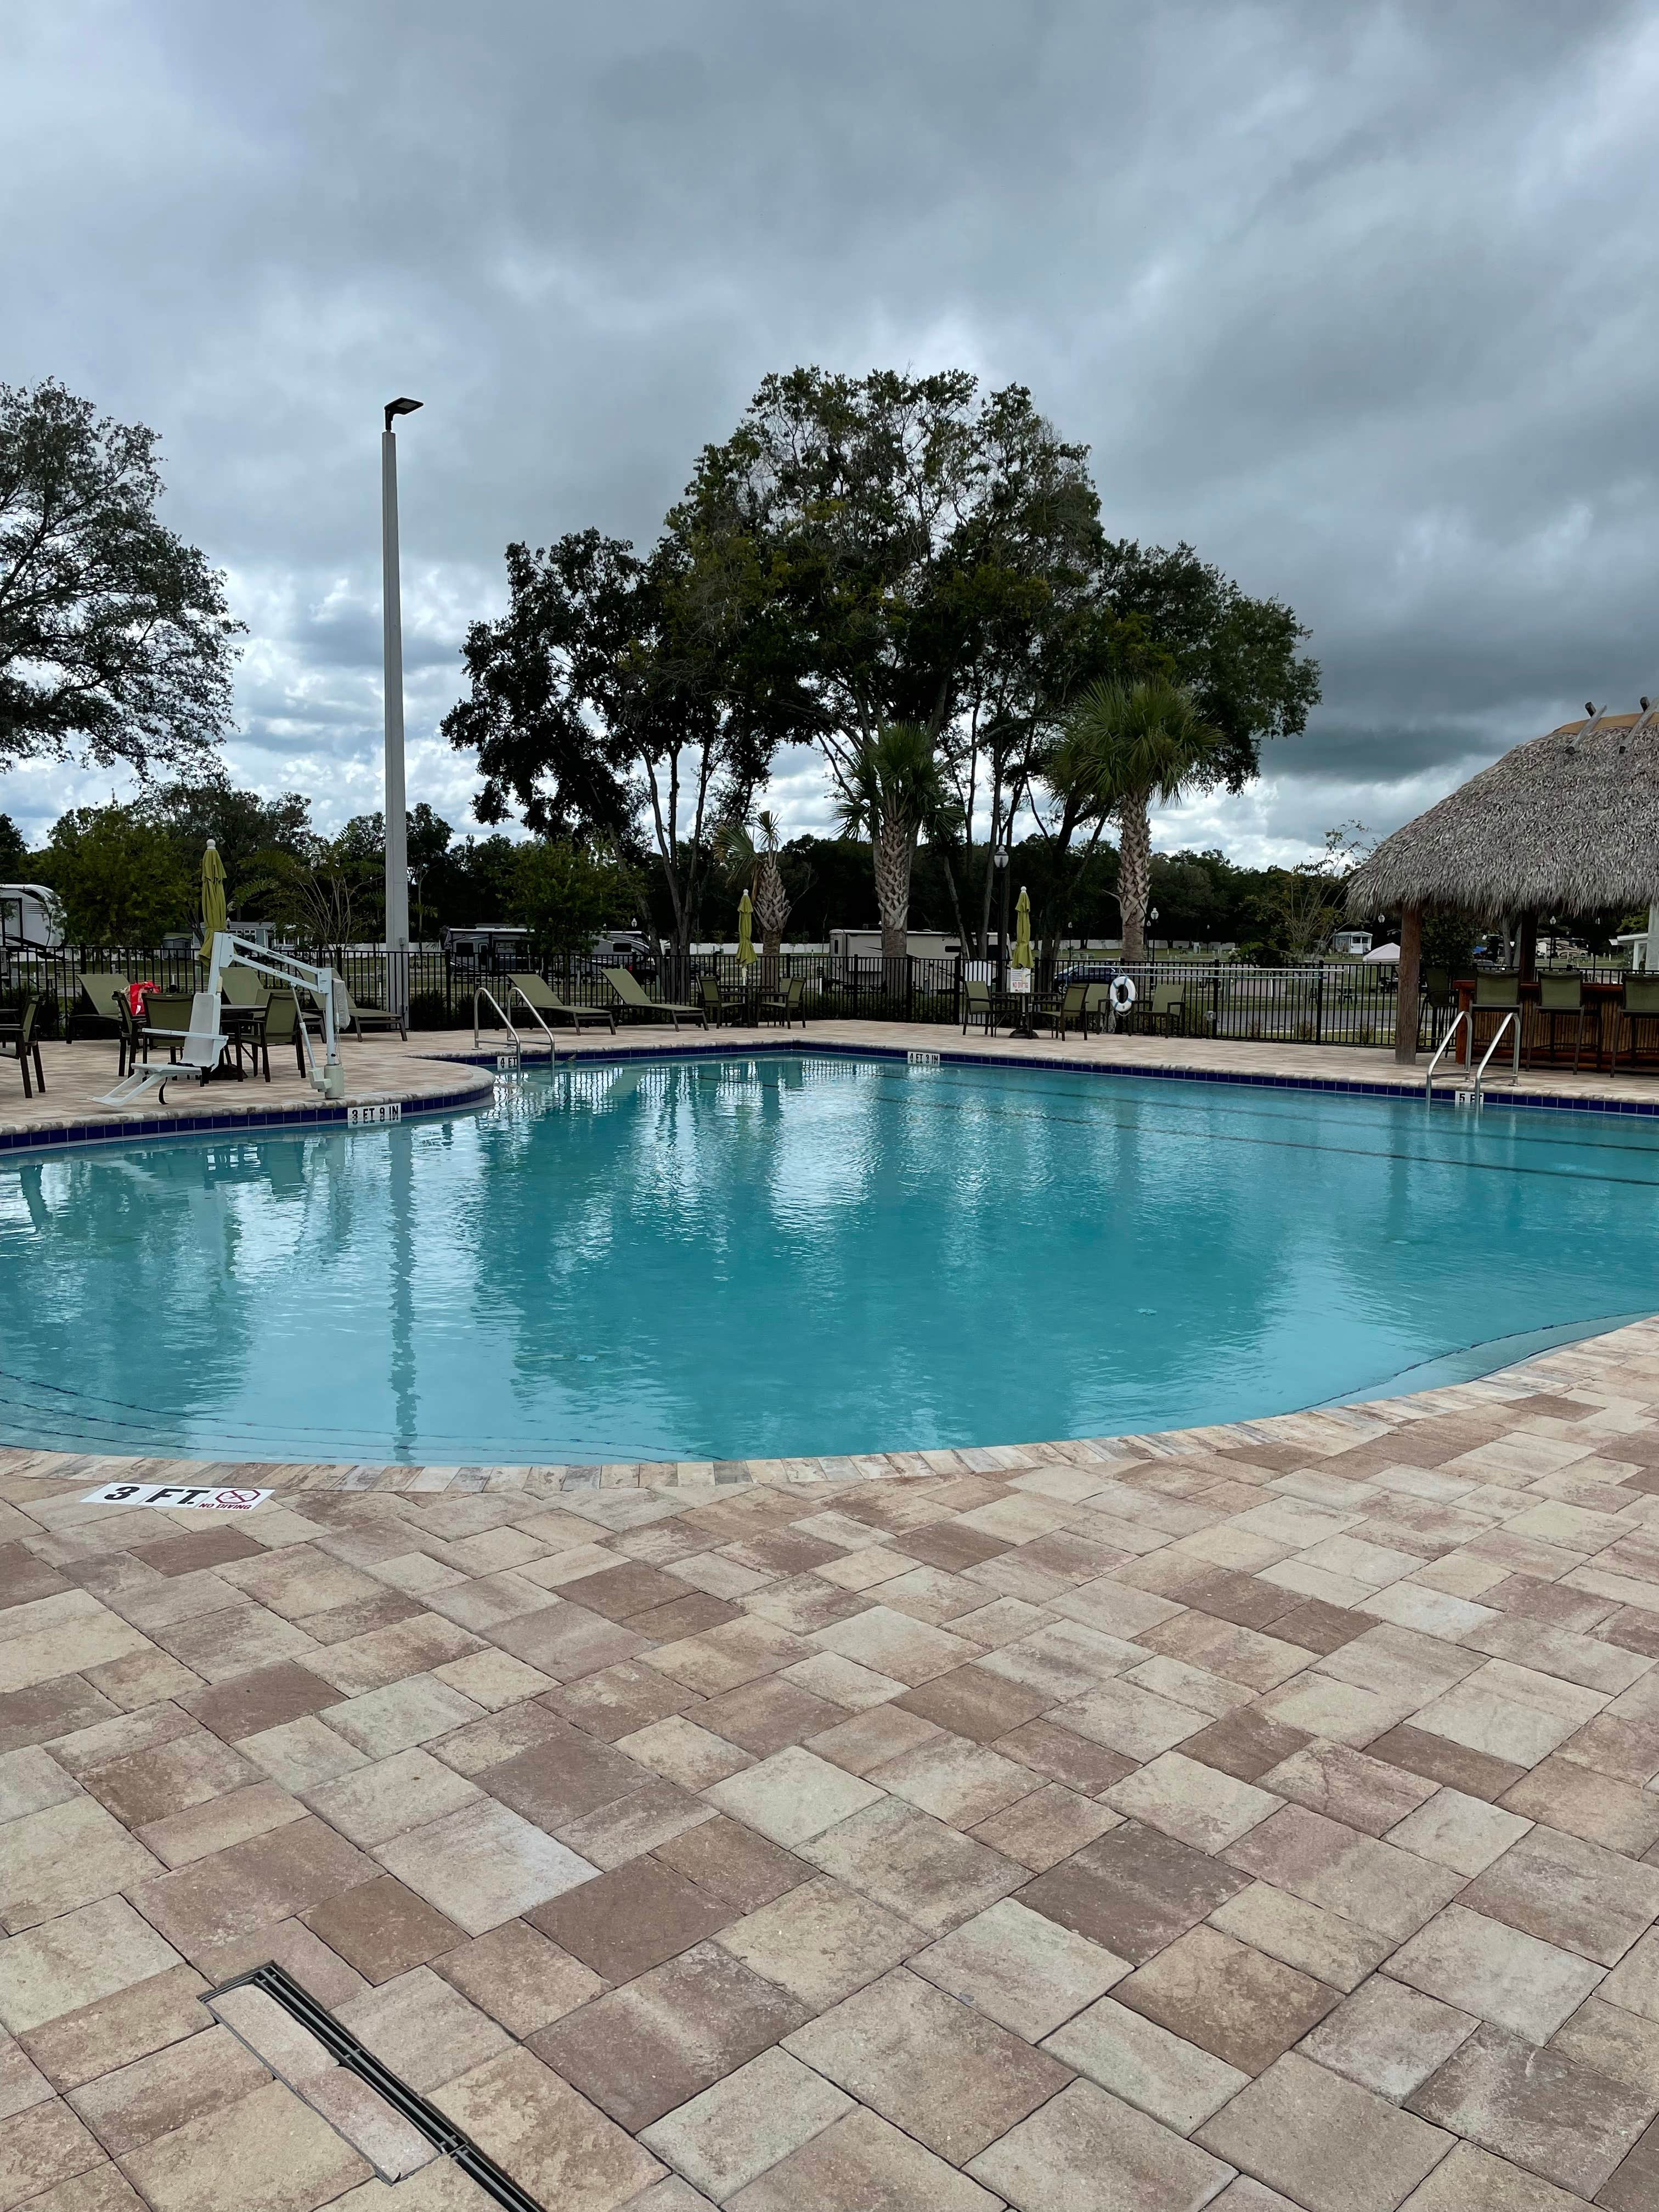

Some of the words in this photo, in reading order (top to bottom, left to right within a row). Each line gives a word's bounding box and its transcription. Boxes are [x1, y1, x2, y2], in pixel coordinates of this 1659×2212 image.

[500, 509, 505, 519] 4
[1459, 1093, 1465, 1102] 5
[352, 1109, 358, 1124] 3
[380, 1107, 385, 1121] 9
[389, 1105, 398, 1121] IN
[104, 1486, 140, 1500] 3
[145, 1488, 211, 1504] FT.
